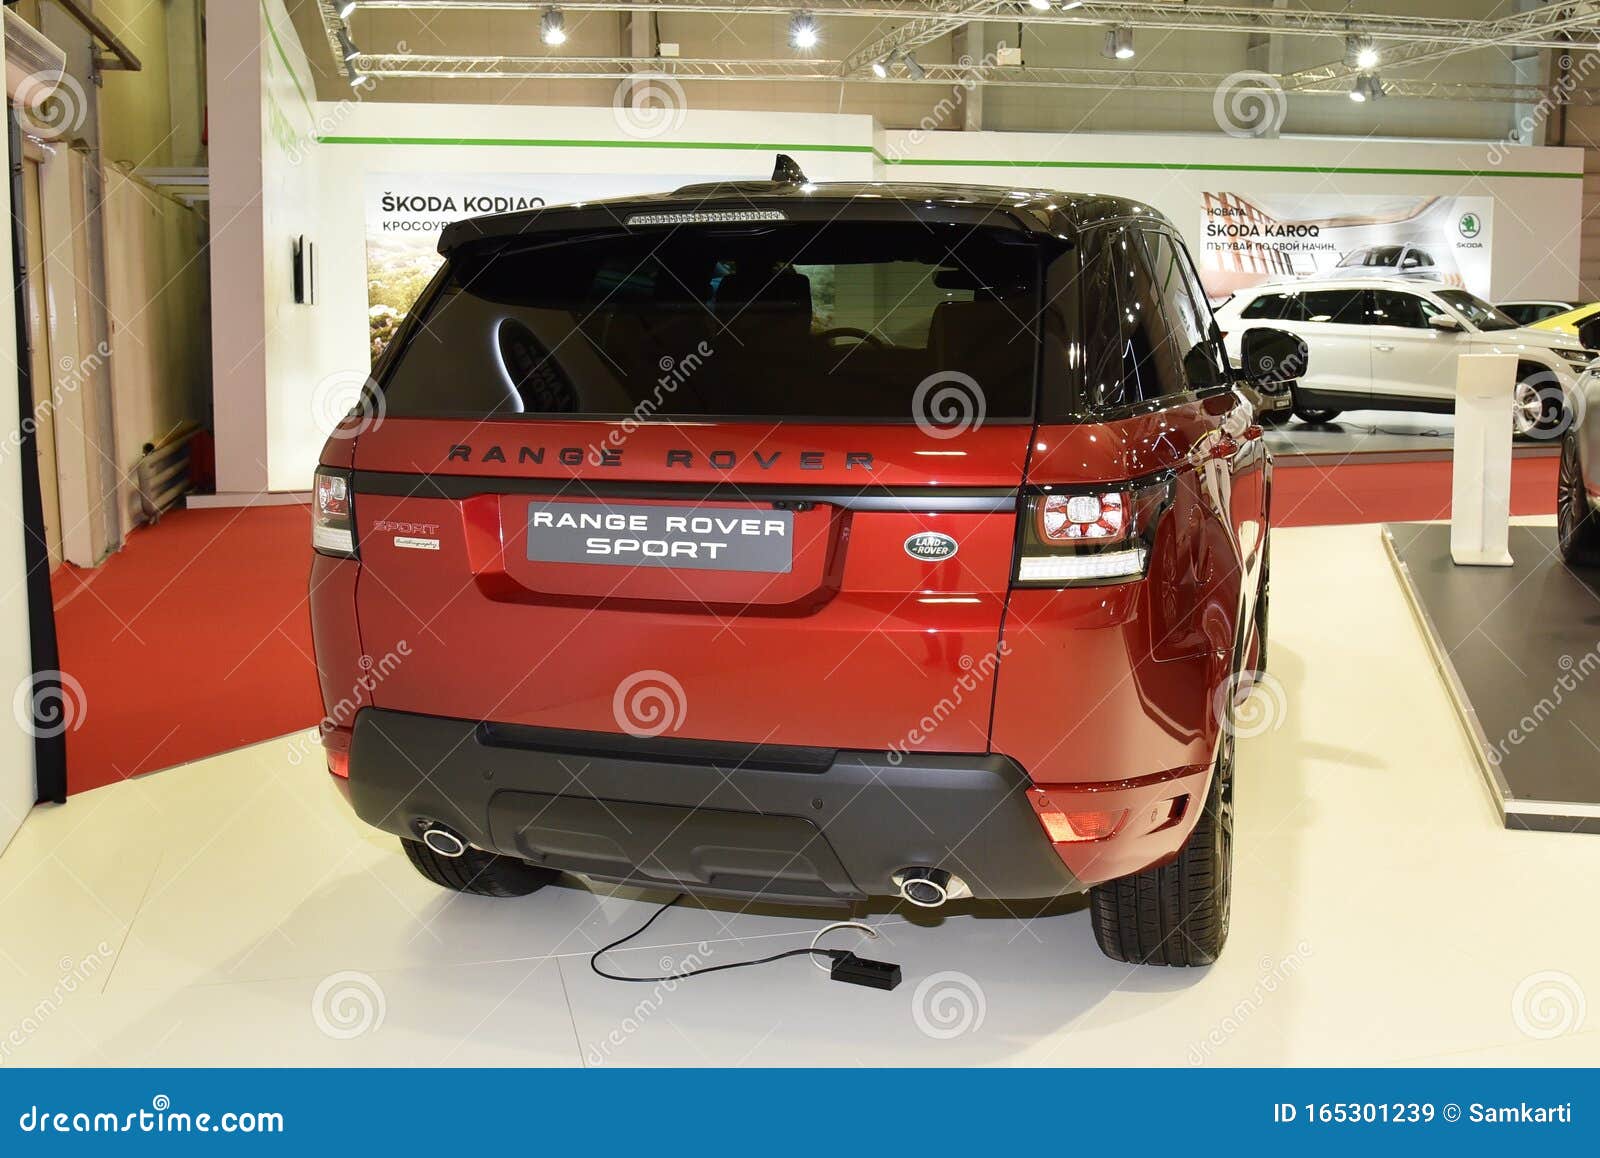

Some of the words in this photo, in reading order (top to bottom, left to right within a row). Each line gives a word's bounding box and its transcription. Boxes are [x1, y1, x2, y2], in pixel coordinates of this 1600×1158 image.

[382, 192, 456, 212] ŠKODA
[1207, 220, 1260, 237] ŠKODA
[1265, 225, 1320, 237] KAROQ
[1272, 241, 1299, 250] СВОЙ
[449, 444, 624, 467] RANGE
[666, 449, 875, 471] ROVER
[374, 520, 440, 534] SPORT
[534, 512, 648, 530] RANGE
[666, 516, 785, 536] ROVER
[586, 538, 728, 559] SPORT
